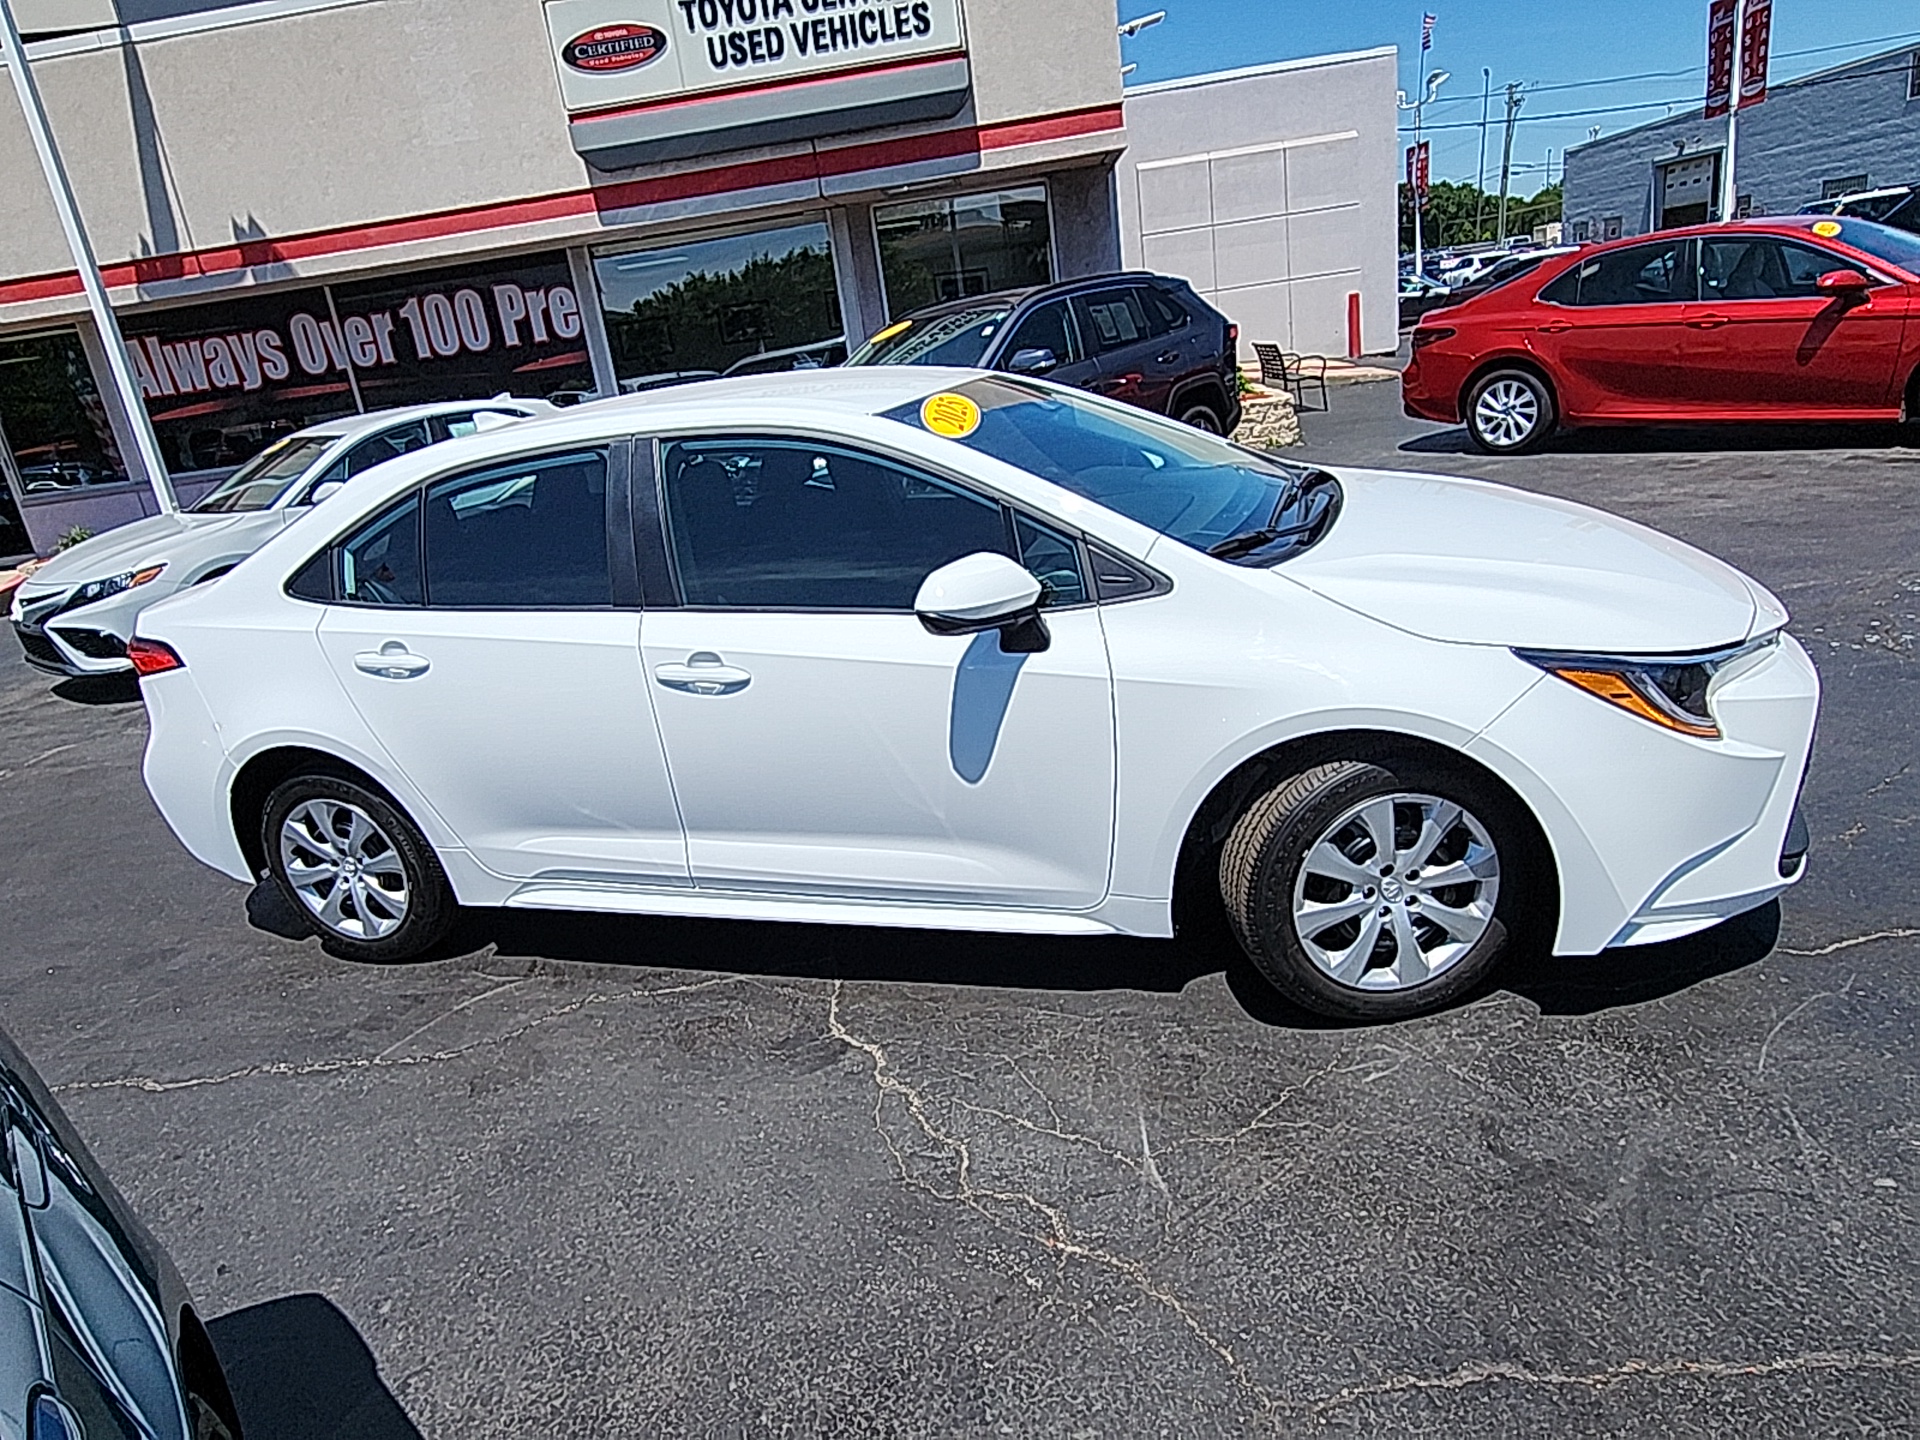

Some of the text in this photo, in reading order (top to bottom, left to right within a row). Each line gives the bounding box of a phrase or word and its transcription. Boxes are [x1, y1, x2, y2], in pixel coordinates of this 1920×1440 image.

[574, 36, 655, 58] CERTIFIED
[707, 2, 931, 69] USED VEHICLES
[125, 282, 582, 398] Always Over 100 Pre
